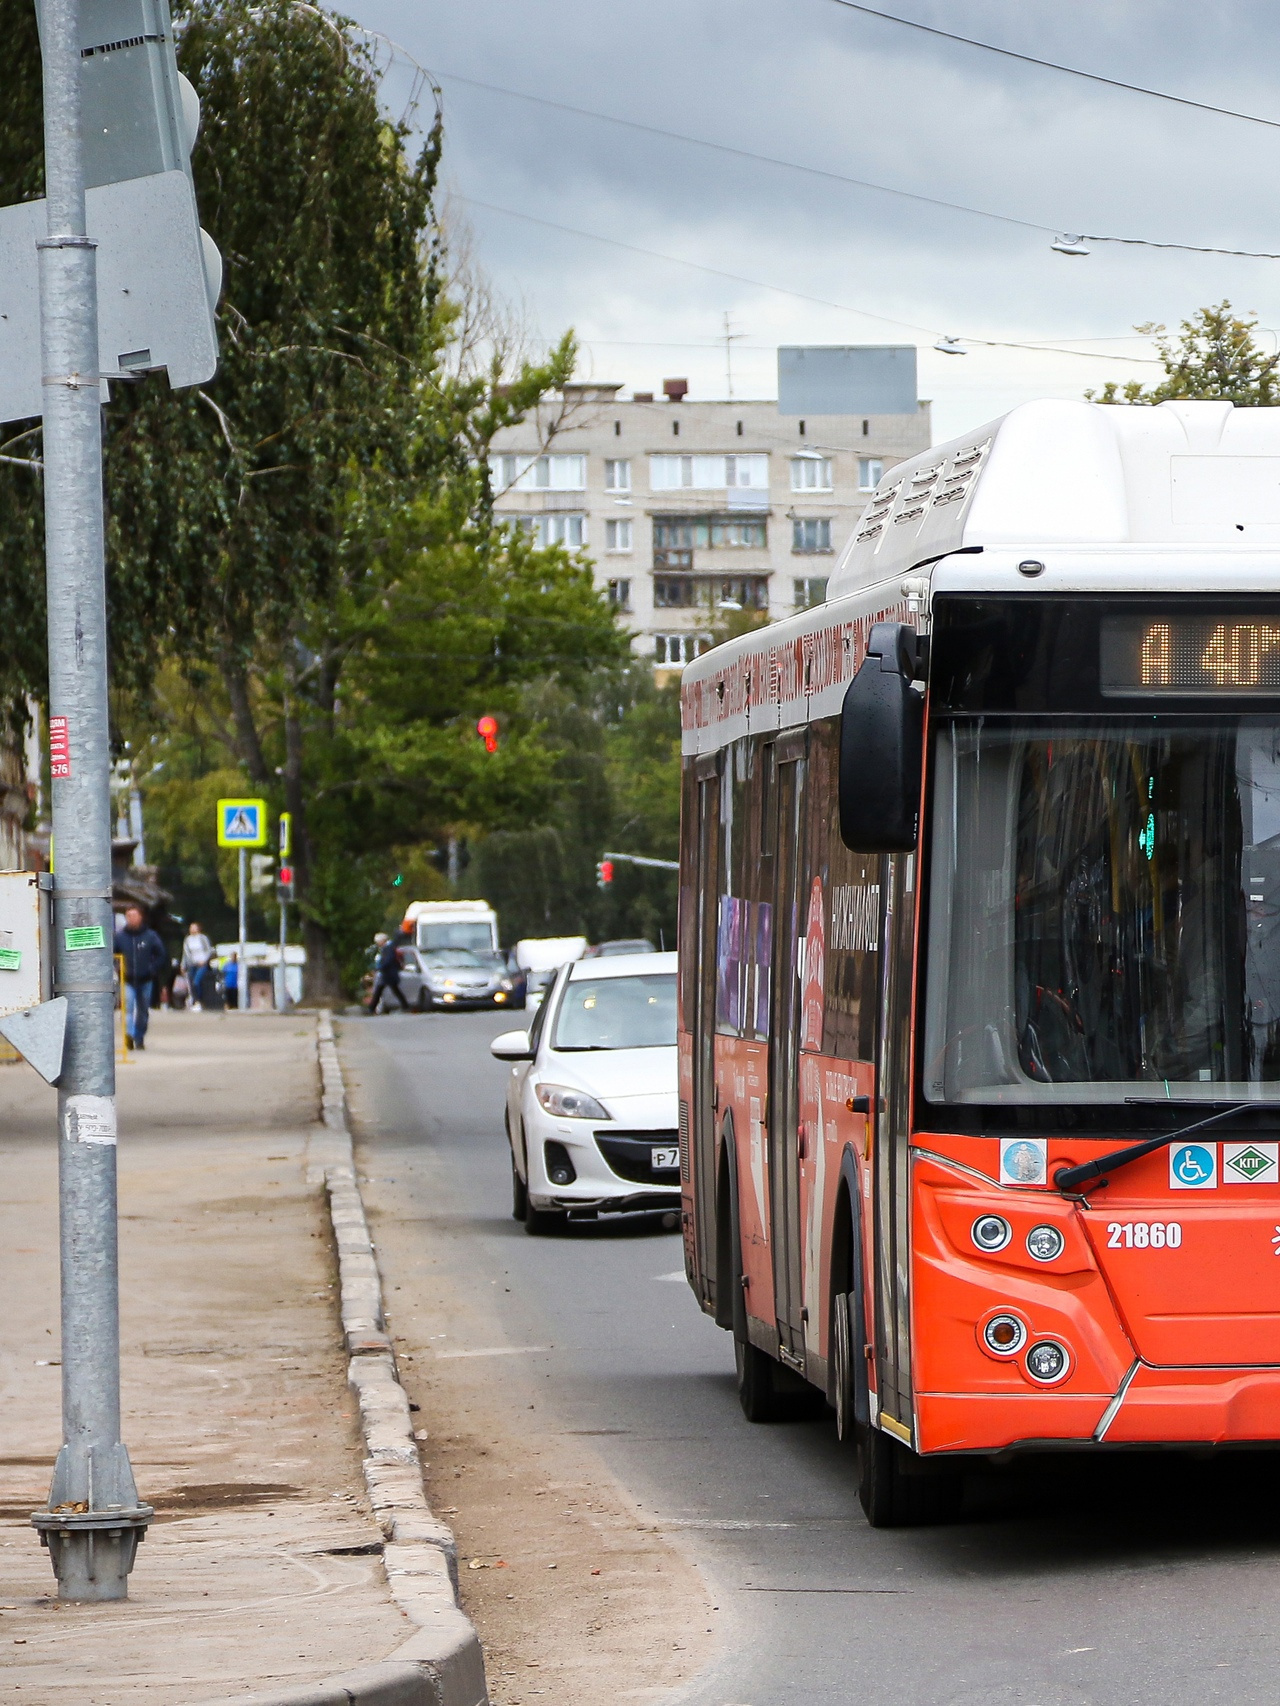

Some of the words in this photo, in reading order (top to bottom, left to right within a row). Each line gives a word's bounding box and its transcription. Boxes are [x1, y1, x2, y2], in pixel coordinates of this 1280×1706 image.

[1201, 623, 1259, 686] 40
[1238, 1157, 1262, 1169] КПГ
[1107, 1222, 1182, 1248] 21860
